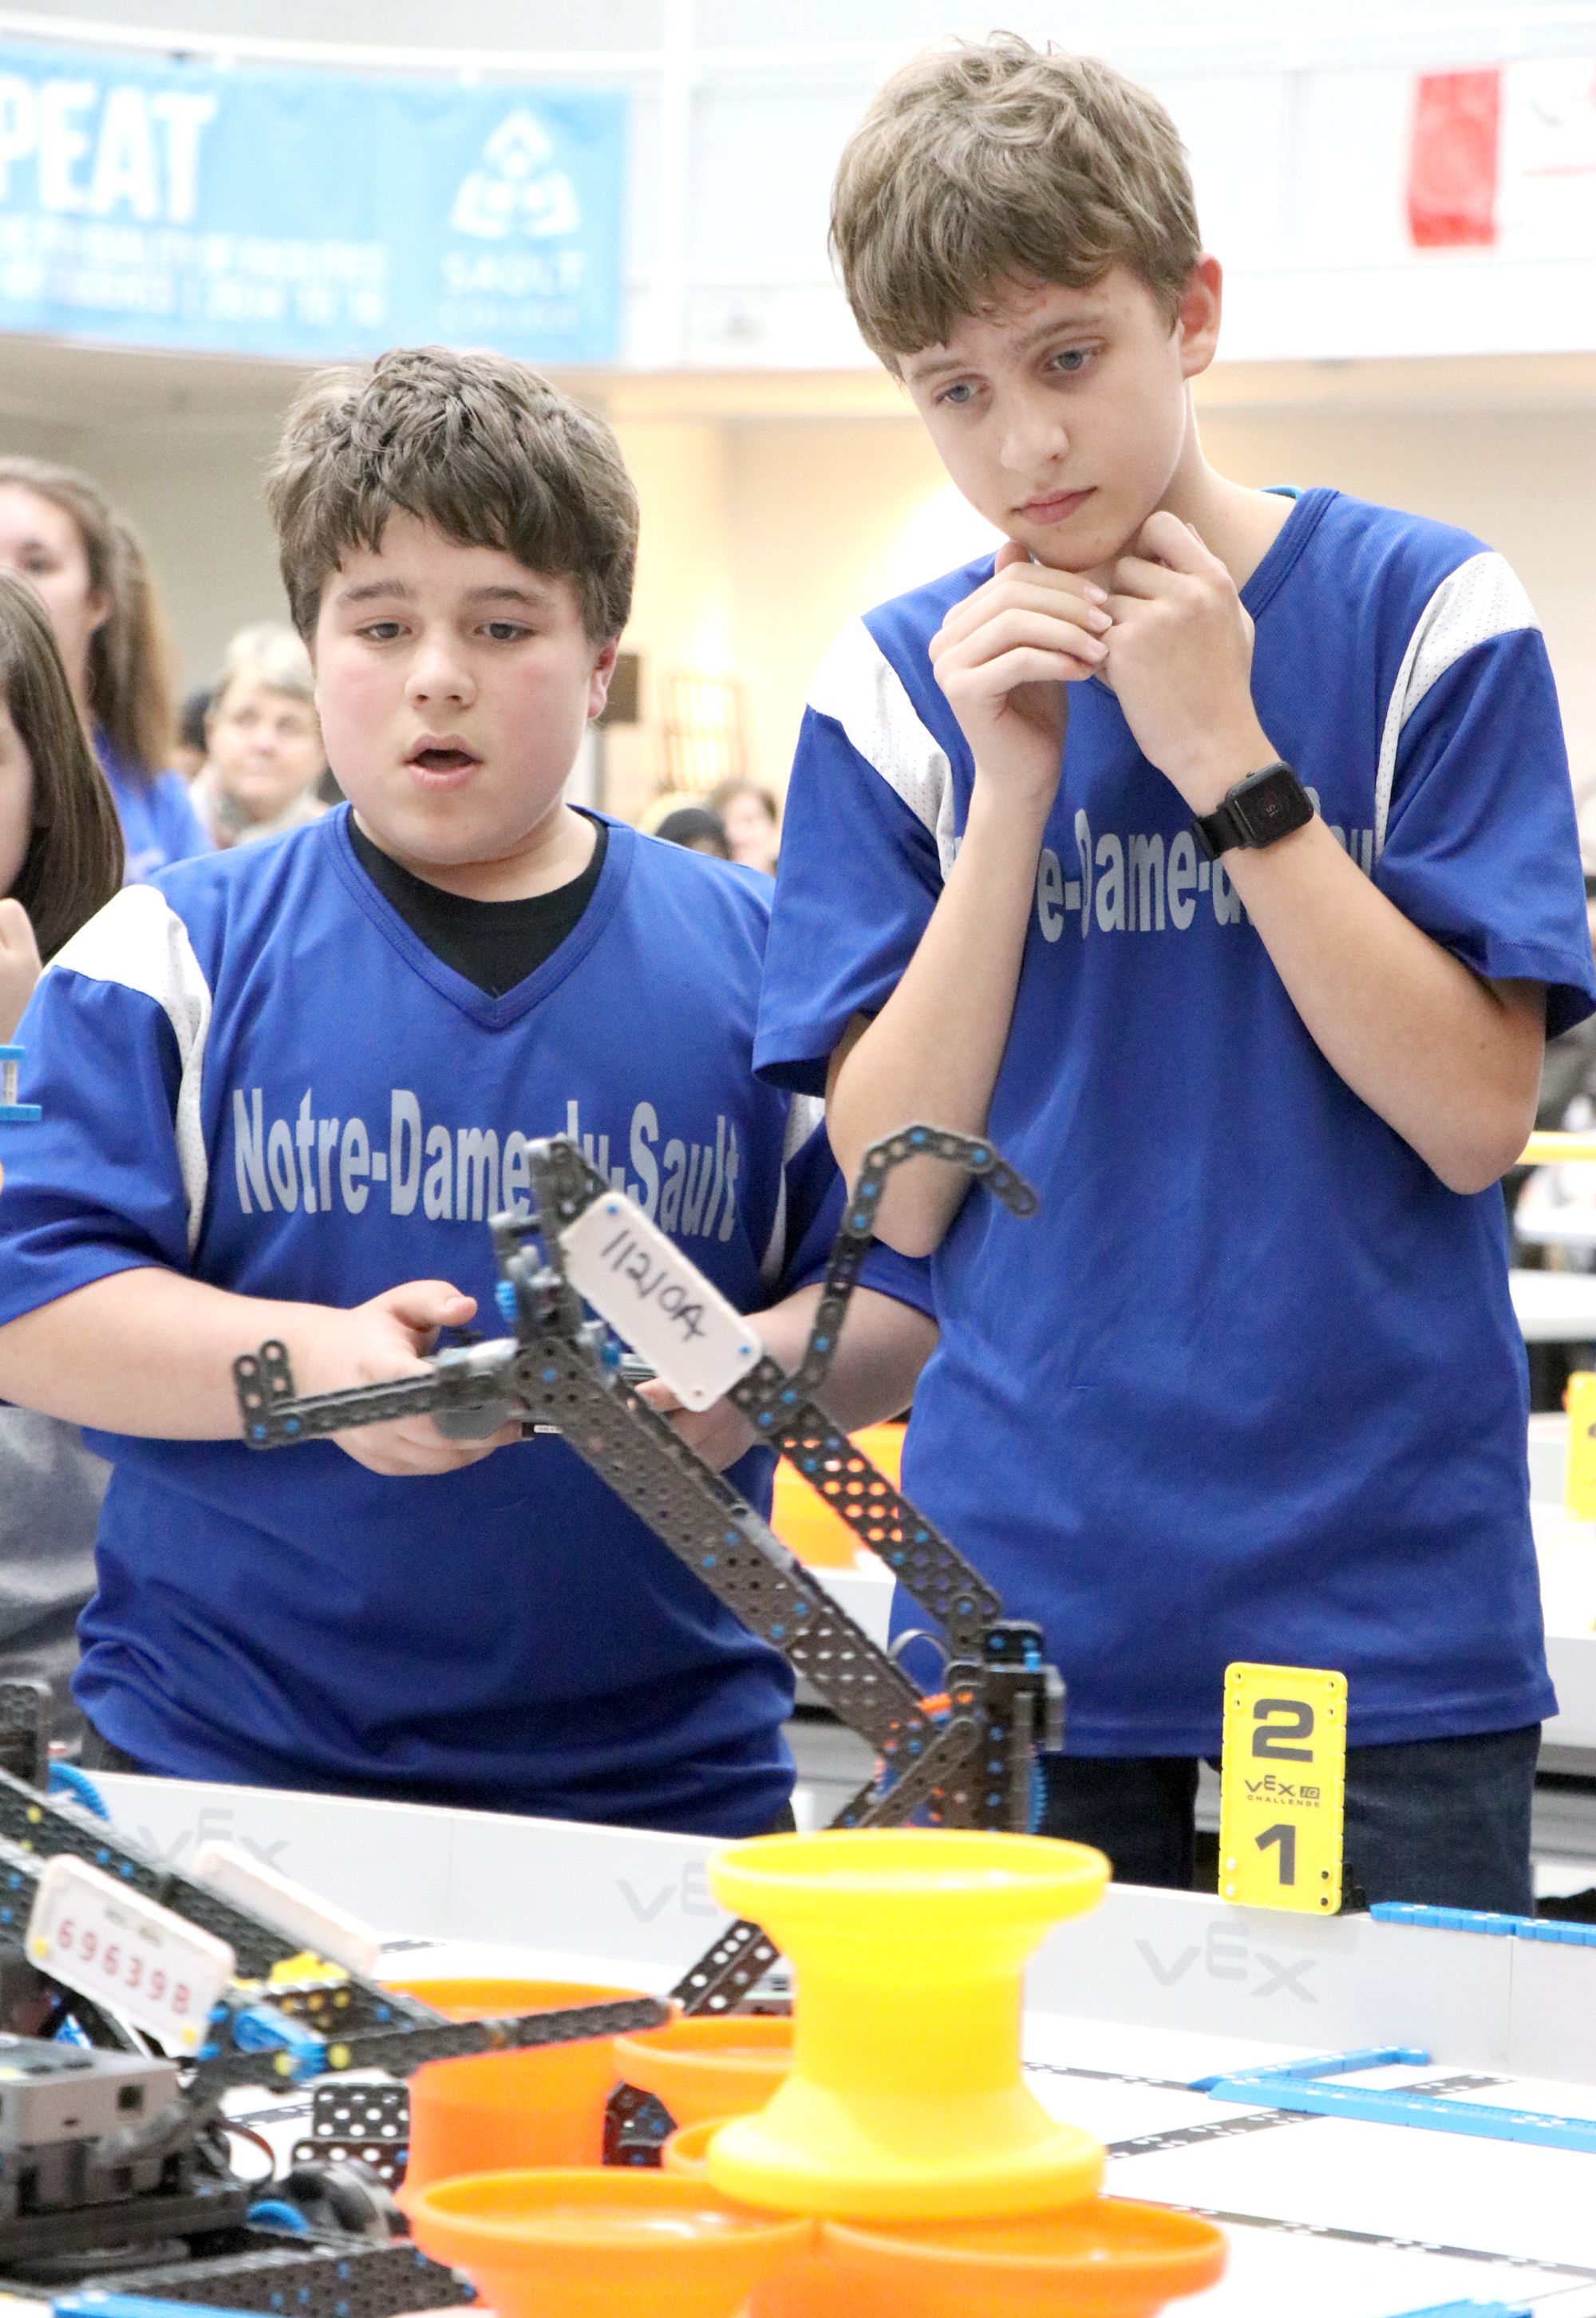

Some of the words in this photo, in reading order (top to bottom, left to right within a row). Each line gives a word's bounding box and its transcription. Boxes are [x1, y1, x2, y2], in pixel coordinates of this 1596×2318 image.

[233, 1087, 740, 1242] Notre-Dame-Sault
[1252, 1699, 1314, 1763] 2
[1245, 1774, 1296, 1797] VEX
[1247, 1795, 1320, 1808] CHALLENGE
[1254, 1824, 1296, 1886] 1
[617, 1861, 718, 1923] VE
[1134, 1920, 1319, 2004] VEX
